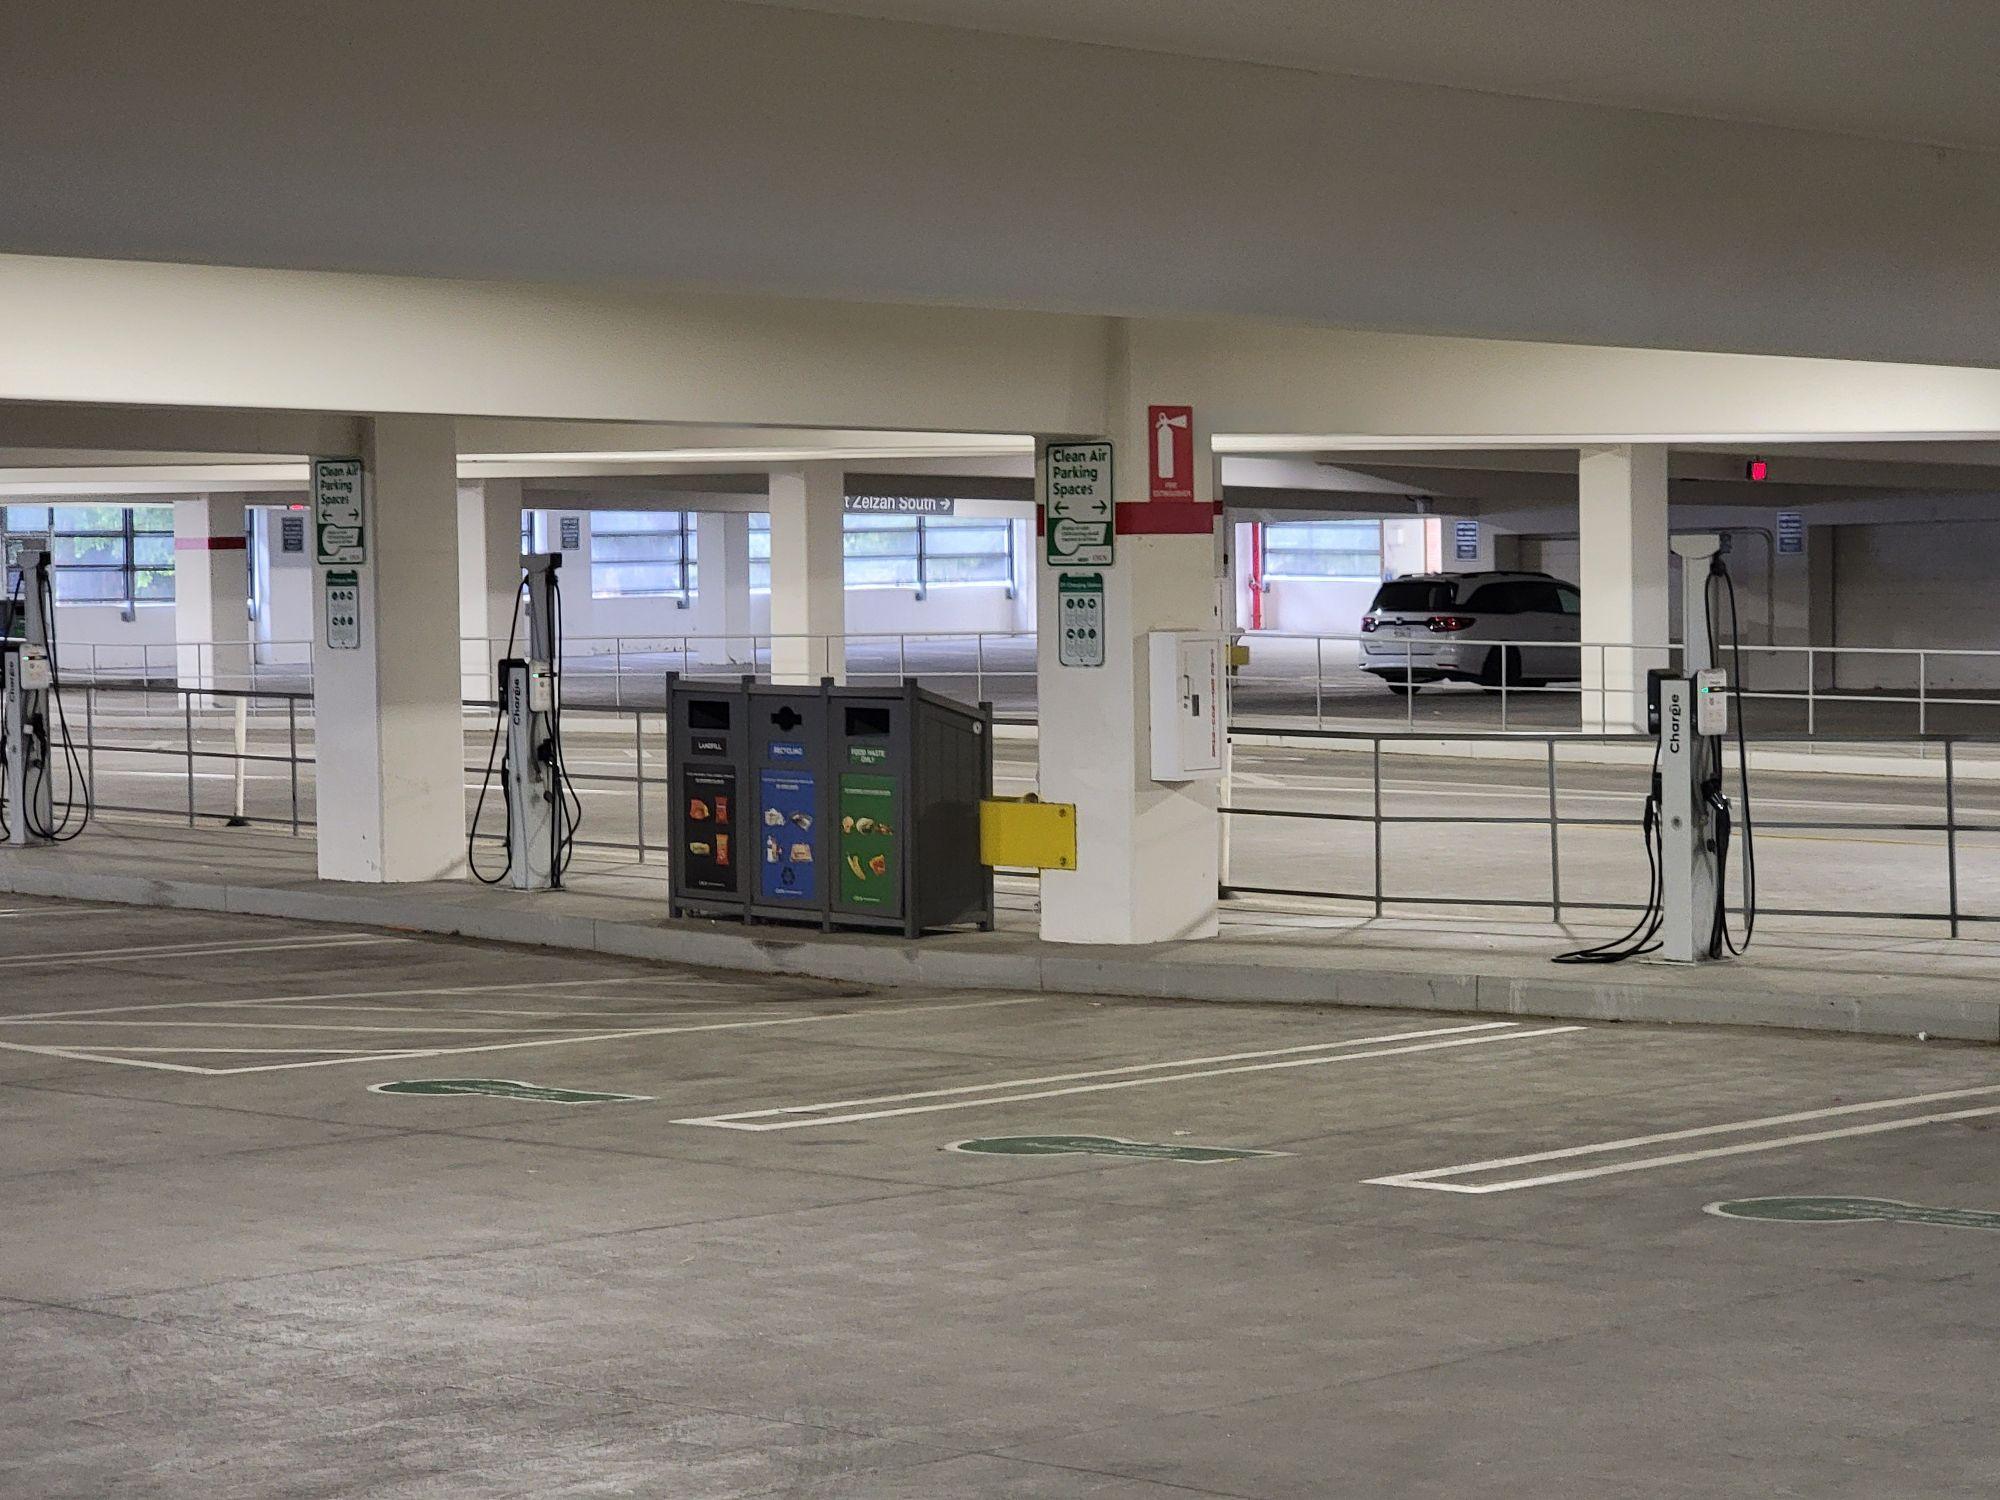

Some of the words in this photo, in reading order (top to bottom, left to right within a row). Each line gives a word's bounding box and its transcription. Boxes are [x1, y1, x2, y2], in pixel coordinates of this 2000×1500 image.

[1053, 449, 1086, 463] Clean
[1090, 448, 1107, 462] Air
[320, 465, 344, 477] Clean
[1053, 465, 1098, 482] Parking
[320, 480, 352, 494] Parking
[1053, 482, 1093, 498] Spaces
[321, 494, 349, 507] Spaces
[513, 678, 521, 726] Chargie
[1669, 694, 1682, 754] Chargie
